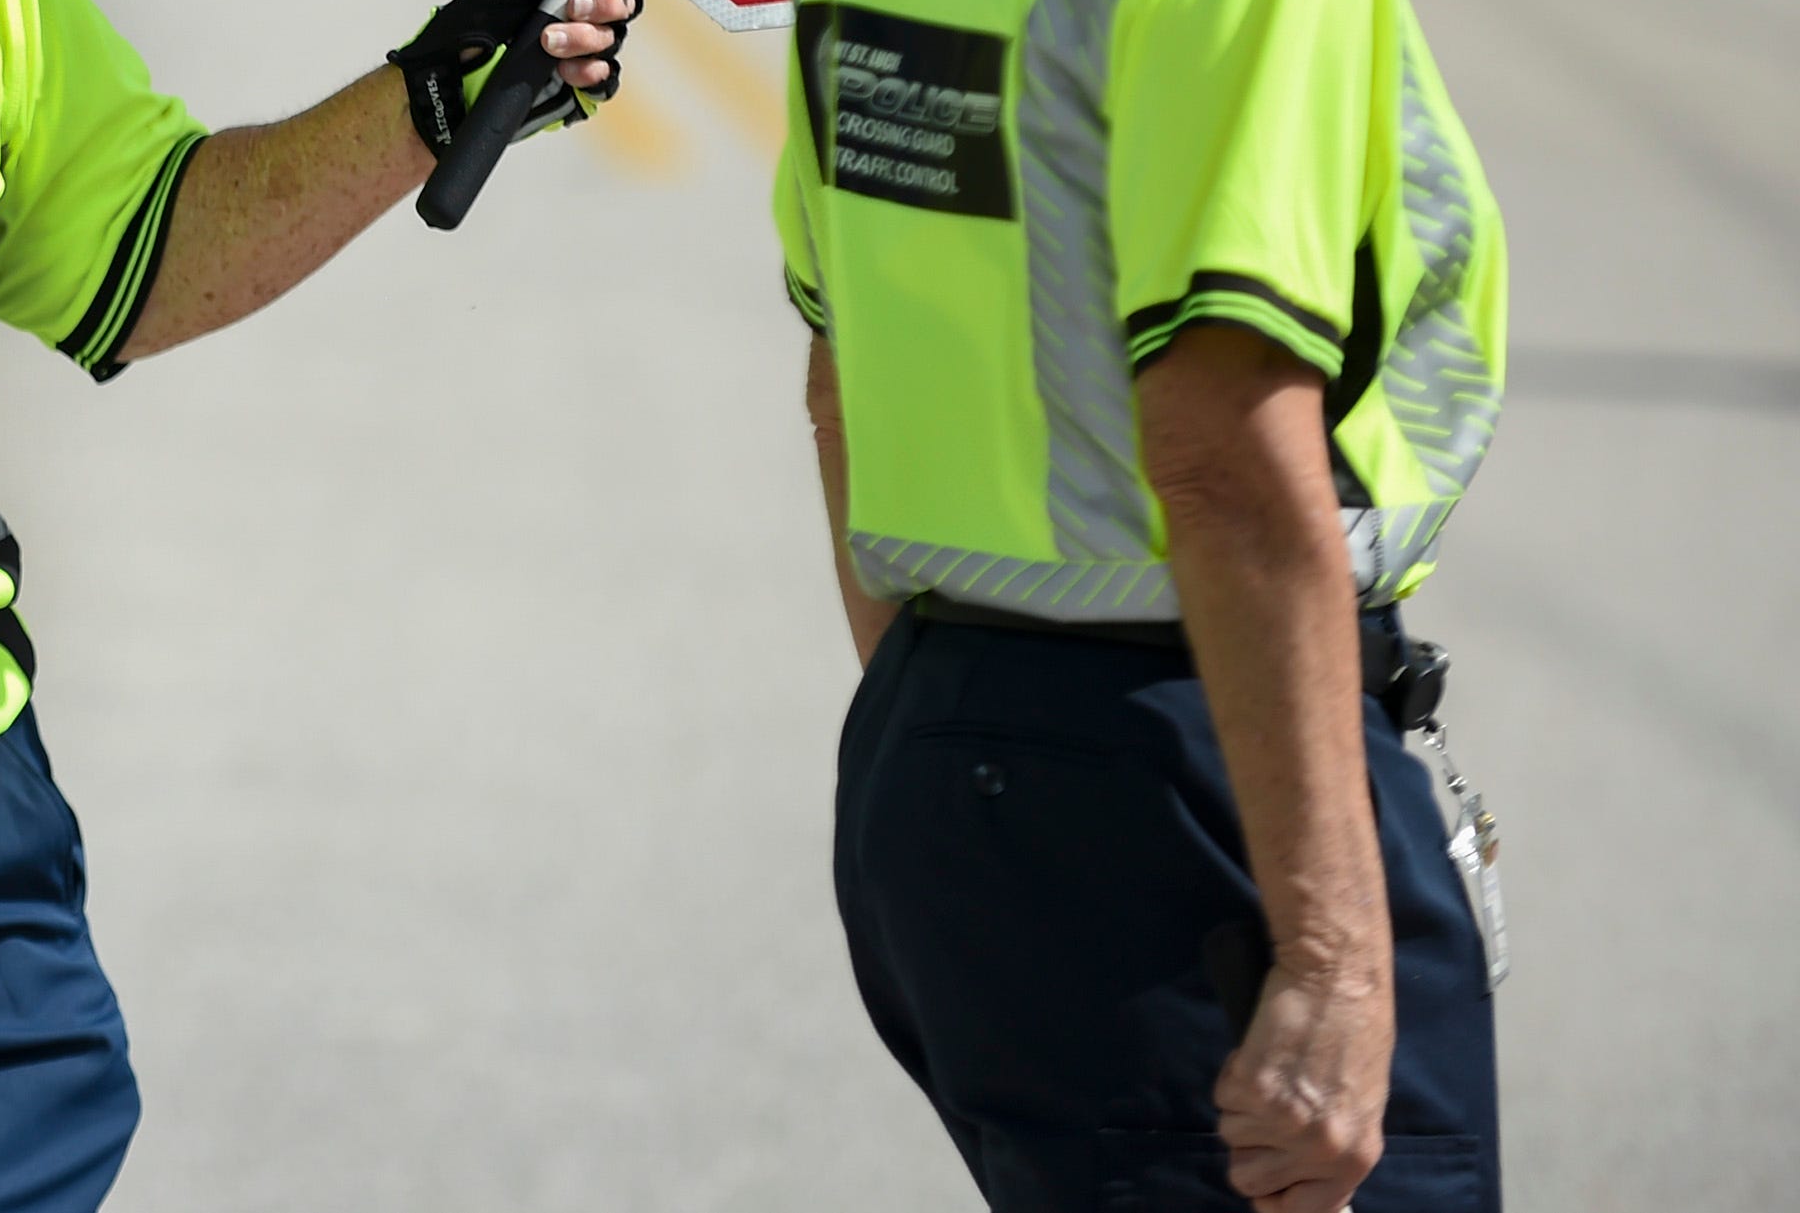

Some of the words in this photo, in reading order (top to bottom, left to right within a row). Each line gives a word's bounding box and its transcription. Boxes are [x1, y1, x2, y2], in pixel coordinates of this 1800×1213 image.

[837, 65, 1001, 133] POLICE
[838, 111, 910, 149] CROSSING
[911, 127, 956, 159] GUARD
[895, 163, 959, 196] CONTROL
